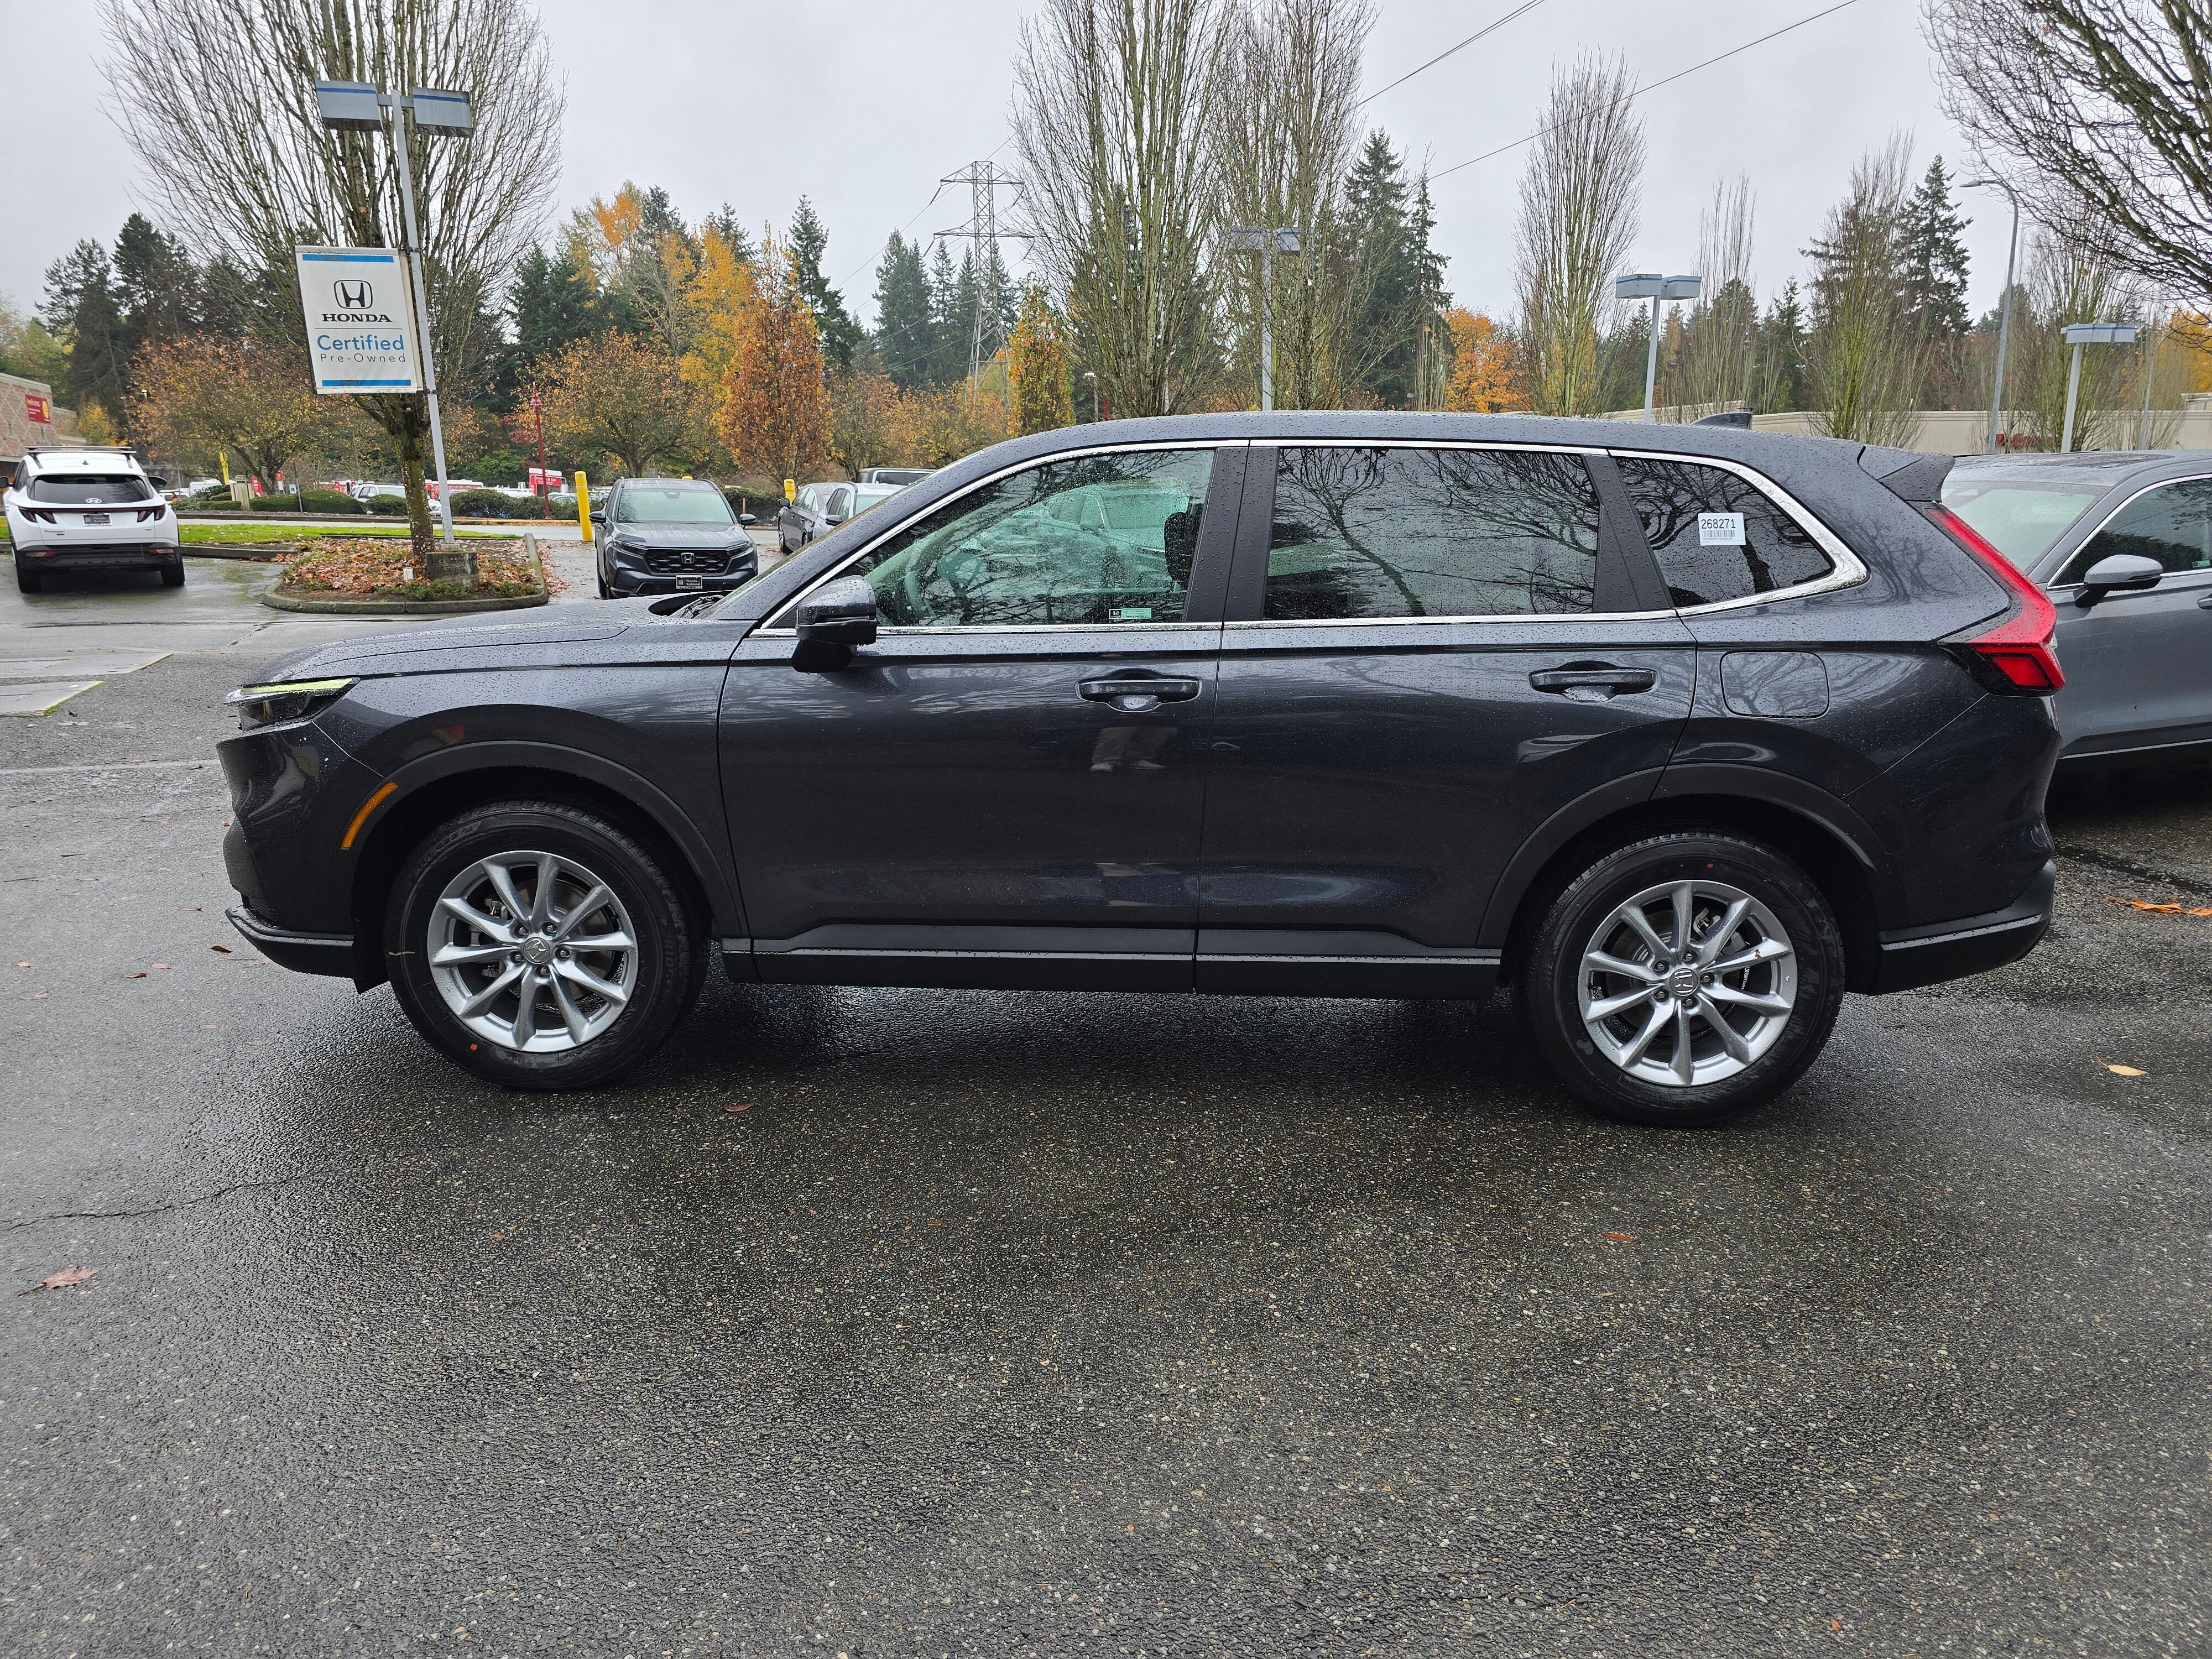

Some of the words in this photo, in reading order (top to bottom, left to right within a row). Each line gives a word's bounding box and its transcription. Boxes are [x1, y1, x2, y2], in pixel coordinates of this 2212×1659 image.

[322, 314, 392, 322] HONDA
[317, 334, 404, 351] Certified
[320, 353, 406, 362] Pre-Owned
[1701, 518, 1736, 529] 268271
